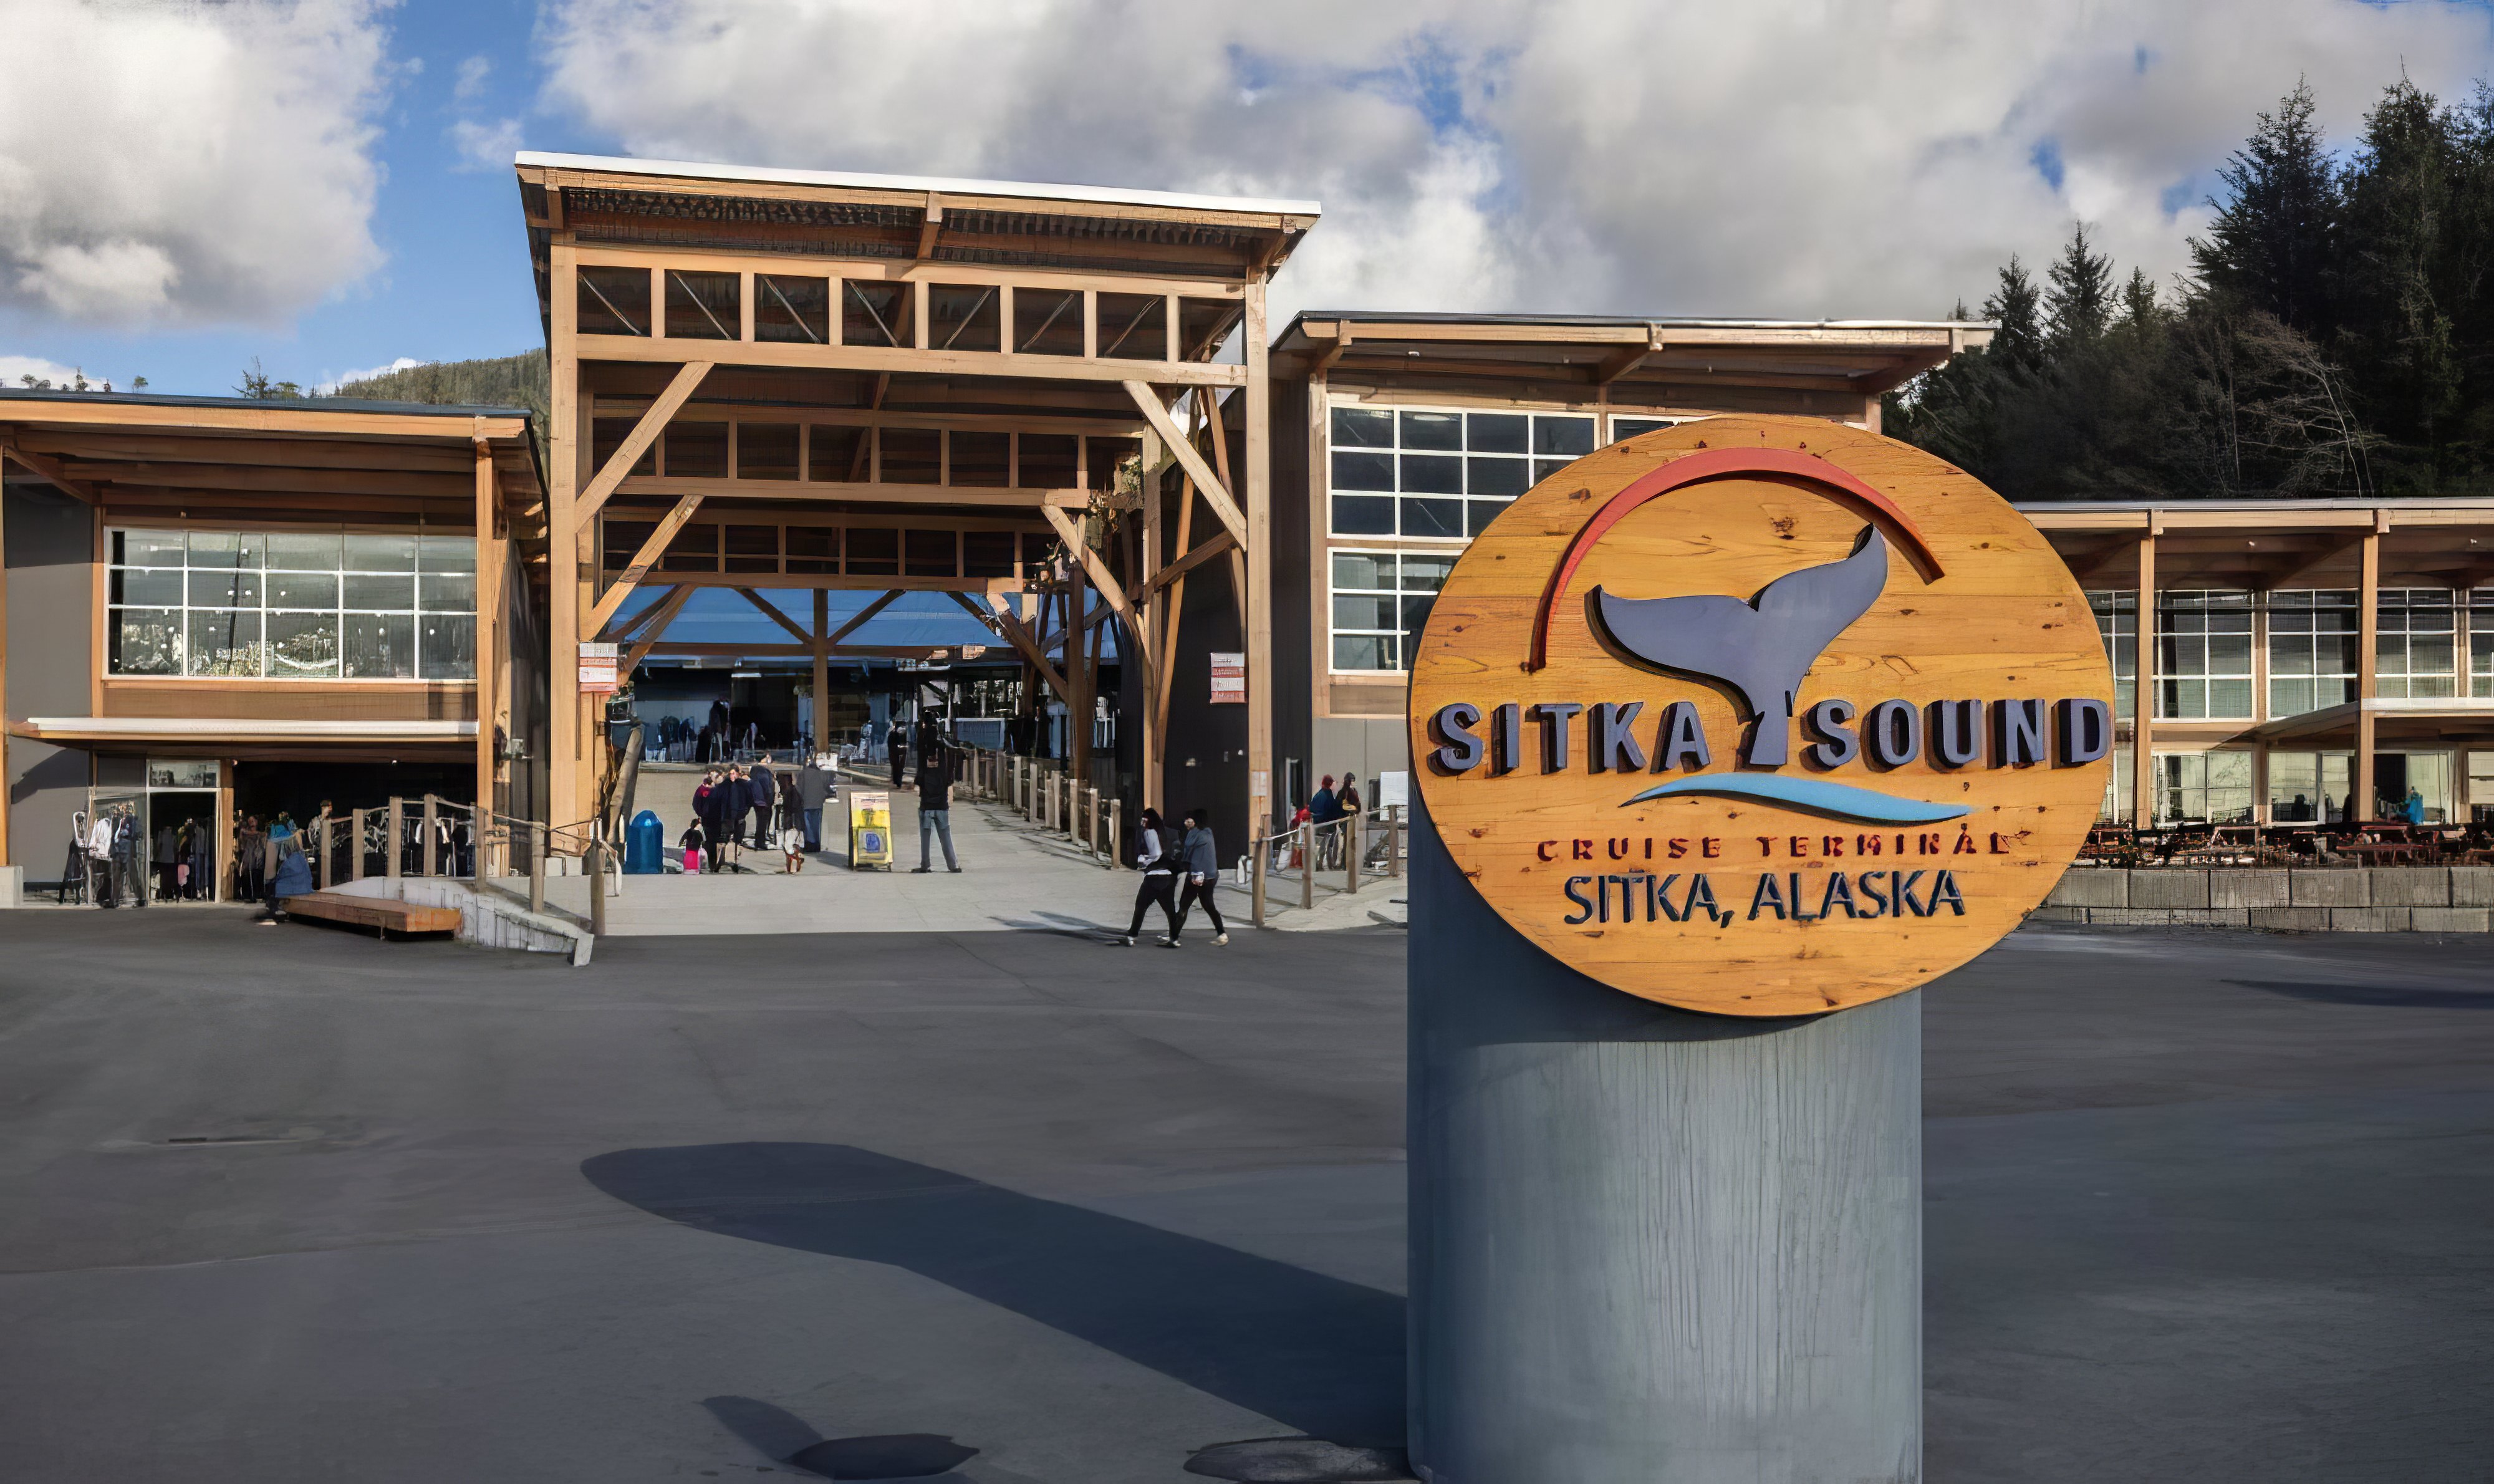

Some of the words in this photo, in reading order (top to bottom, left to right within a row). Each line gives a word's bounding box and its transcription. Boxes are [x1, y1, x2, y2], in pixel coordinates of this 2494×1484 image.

[1427, 701, 1712, 778] SITKA
[1799, 698, 2112, 774] SOUND
[1537, 836, 1722, 862] CRUISE
[1563, 872, 1735, 928] SITKA,
[1746, 869, 1966, 920] ALASKA
